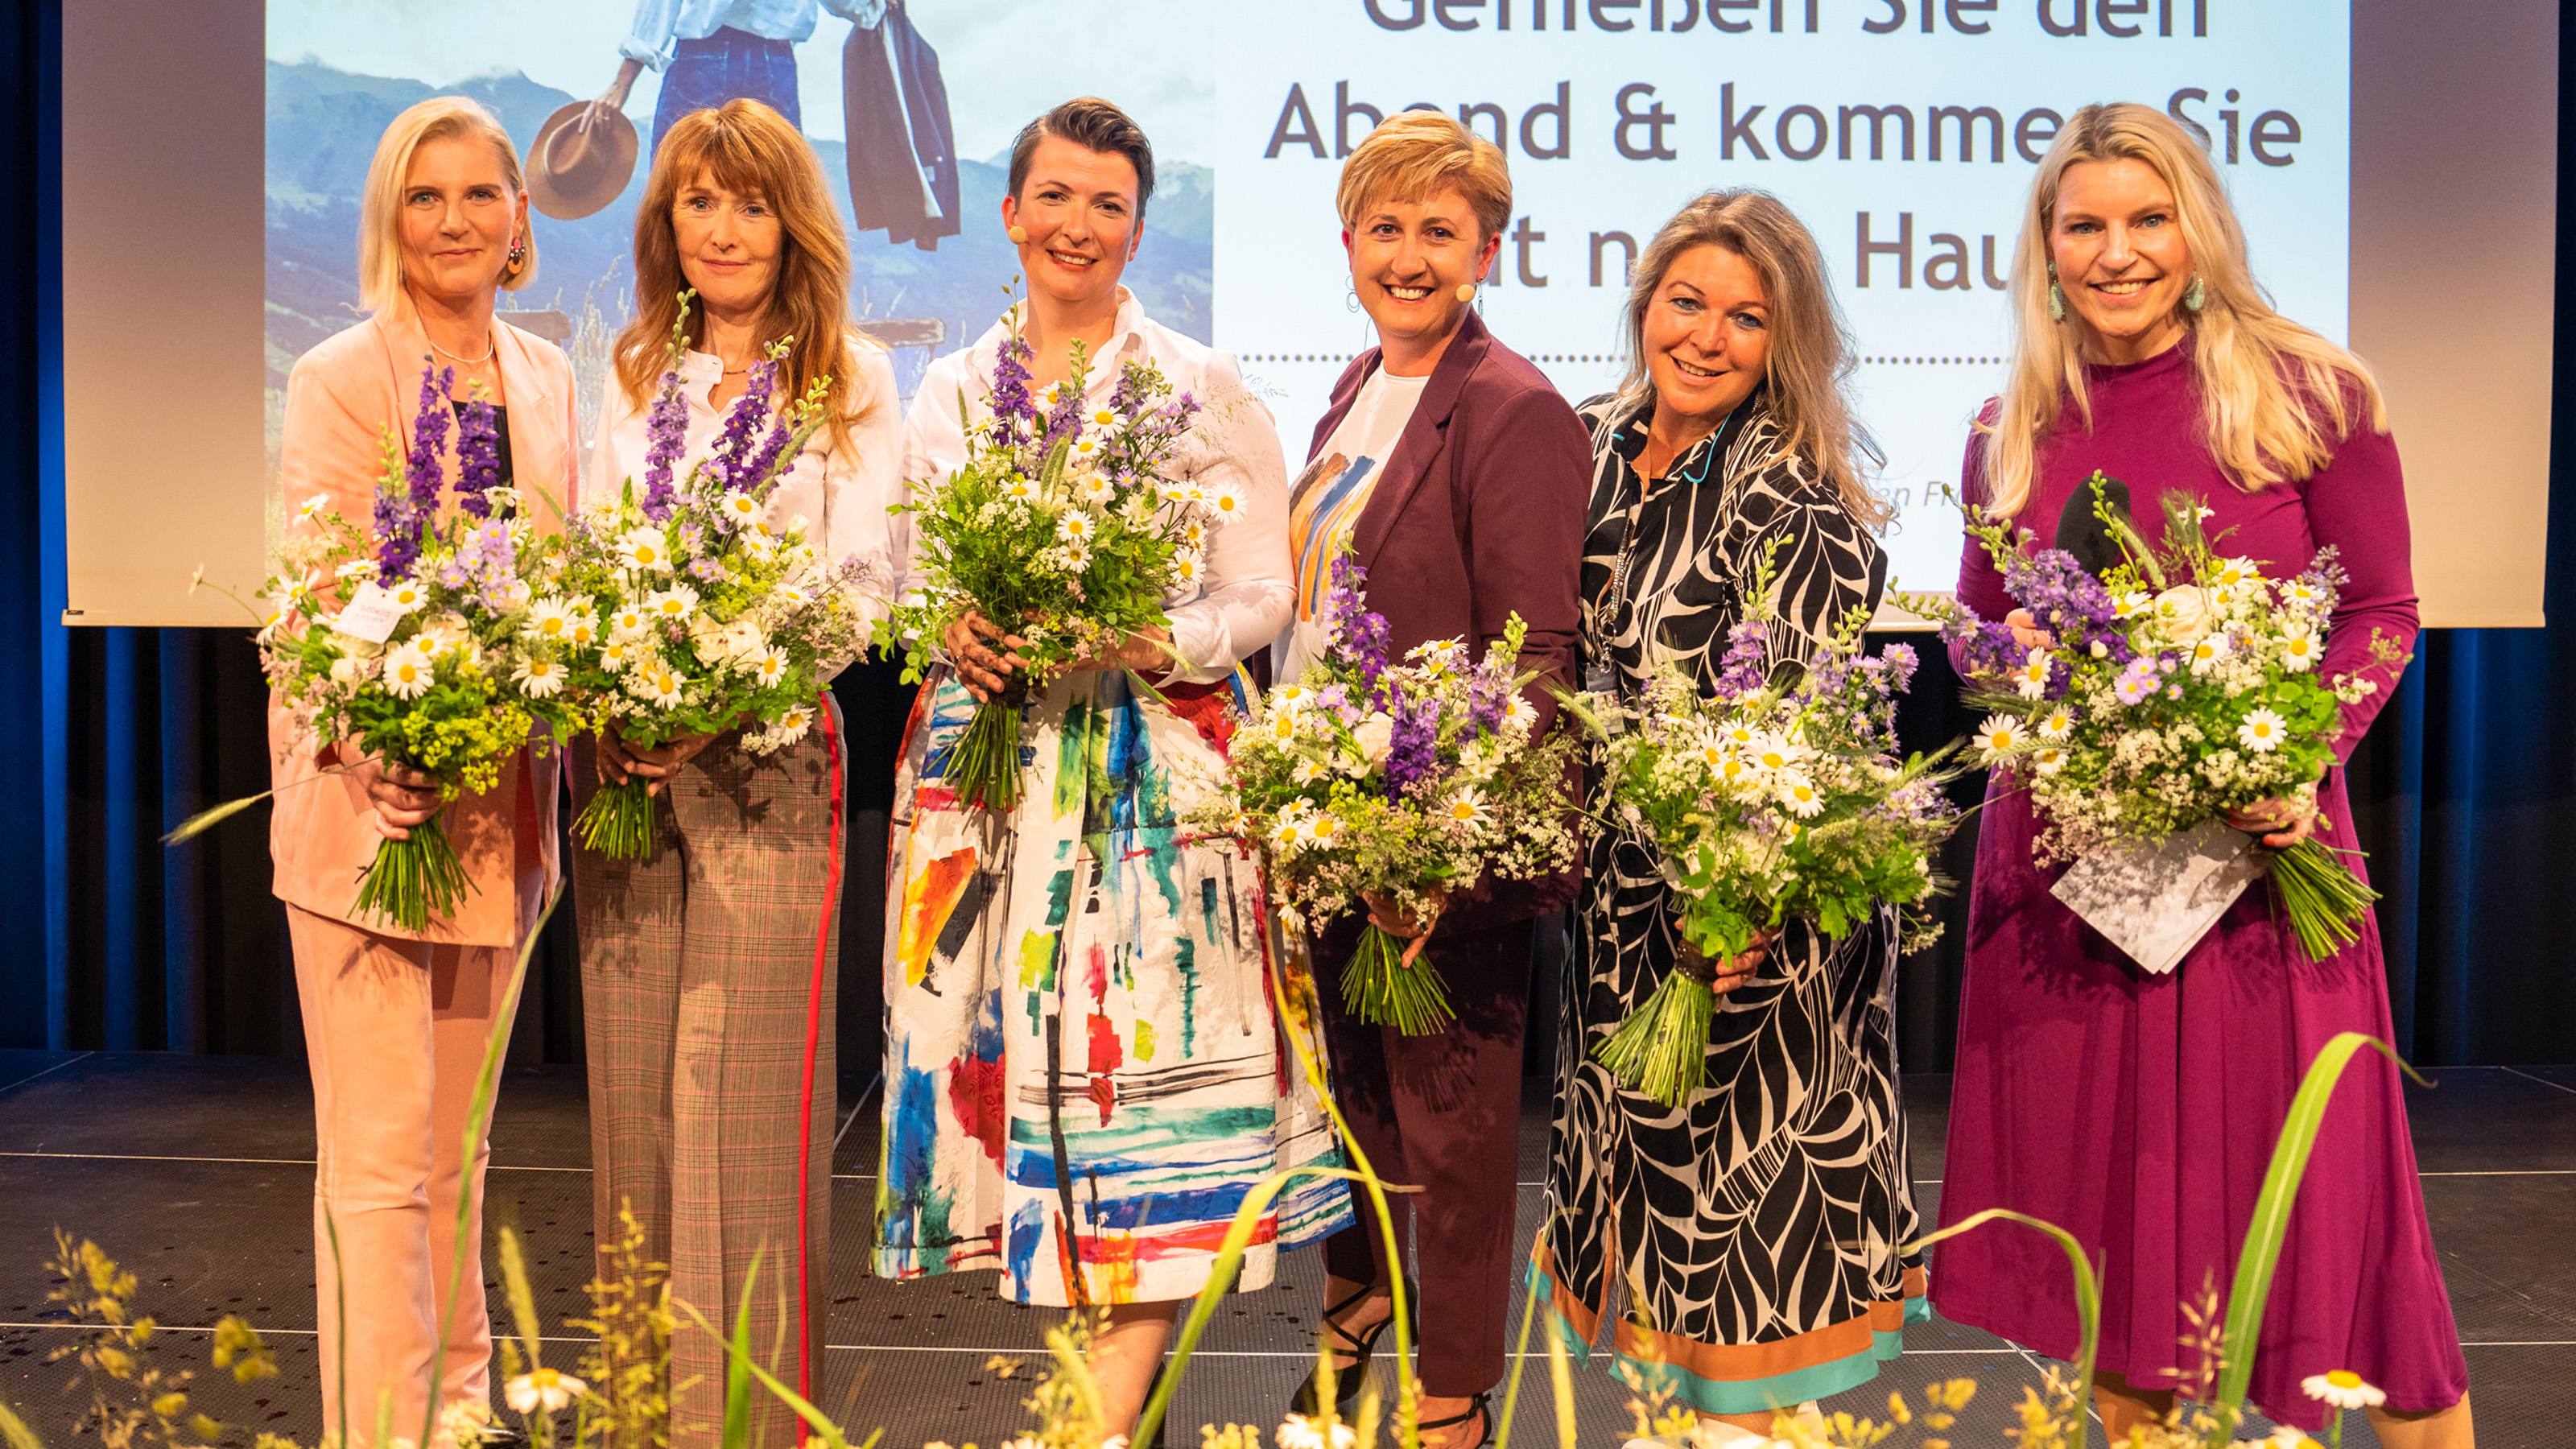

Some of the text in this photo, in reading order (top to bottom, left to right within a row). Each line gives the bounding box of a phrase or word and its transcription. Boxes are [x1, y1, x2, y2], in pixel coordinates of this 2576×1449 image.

[1264, 79, 2302, 167] Abnd & komme Sie
[1856, 211, 2010, 291] Hau
